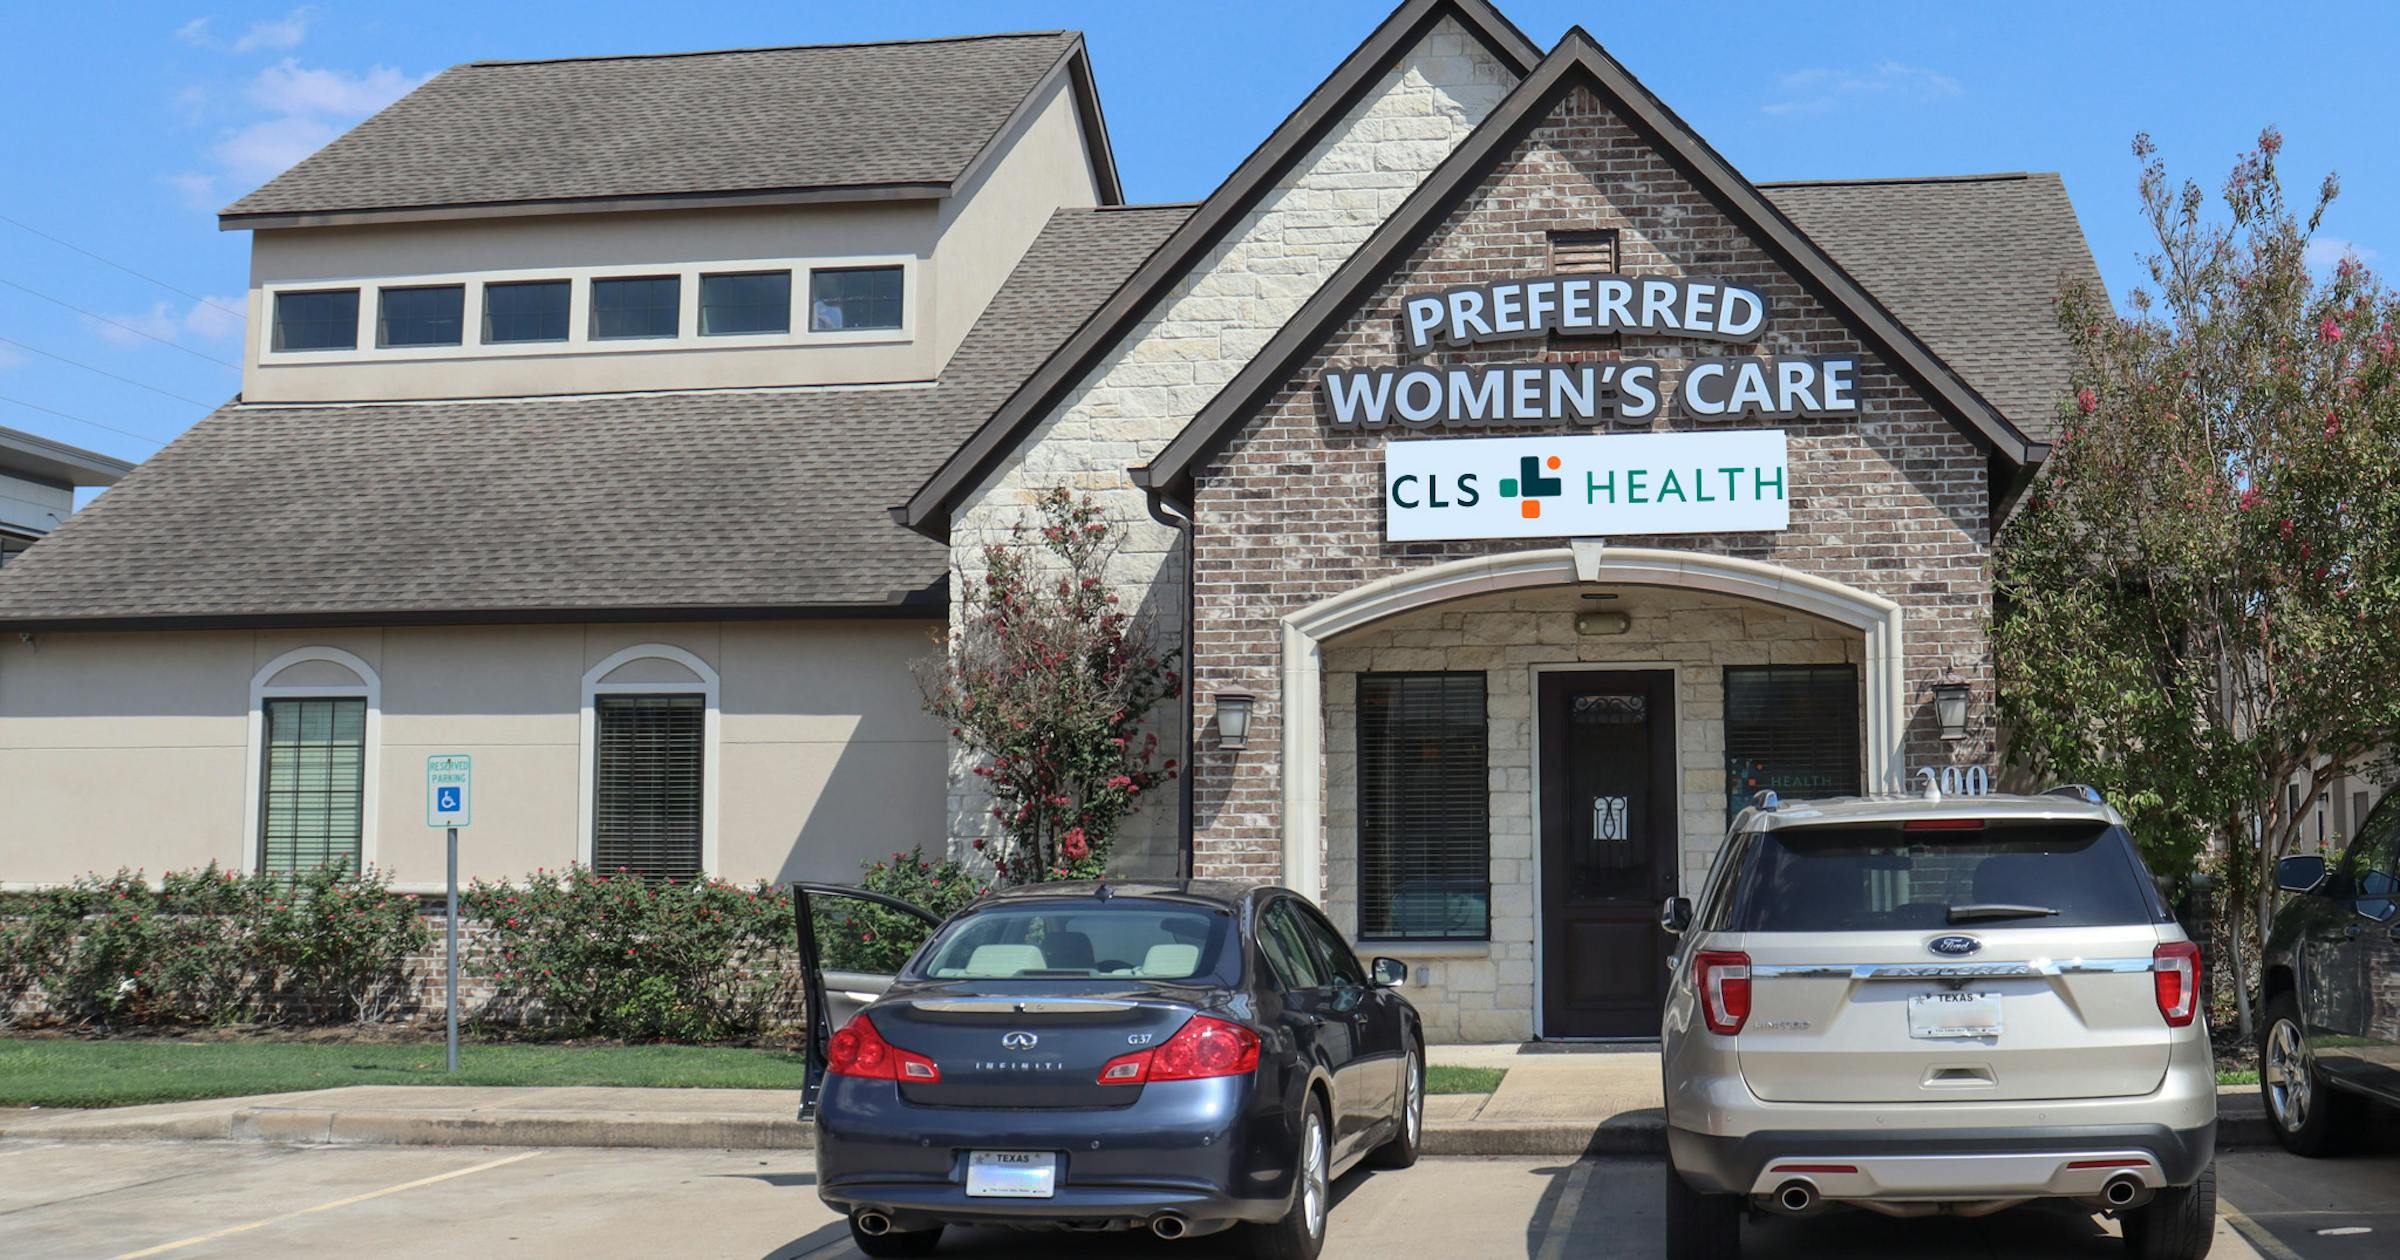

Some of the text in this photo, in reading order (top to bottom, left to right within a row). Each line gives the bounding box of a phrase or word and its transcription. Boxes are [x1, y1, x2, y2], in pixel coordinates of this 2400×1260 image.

[1407, 279, 1765, 348] PREFERRED
[1684, 360, 1857, 415] CARE
[1391, 466, 1784, 508] CLS HEALTH
[429, 760, 469, 771] RESERVED
[431, 773, 466, 784] PARKING
[1770, 775, 1833, 788] HEALTH
[1940, 937, 1970, 951] Ford
[1882, 964, 2030, 977] EXPLORER
[1938, 993, 1974, 1003] TEXAS
[1127, 1033, 1152, 1045] G37
[975, 1061, 1063, 1070] INFINITI
[996, 1153, 1030, 1164] TEXAS
